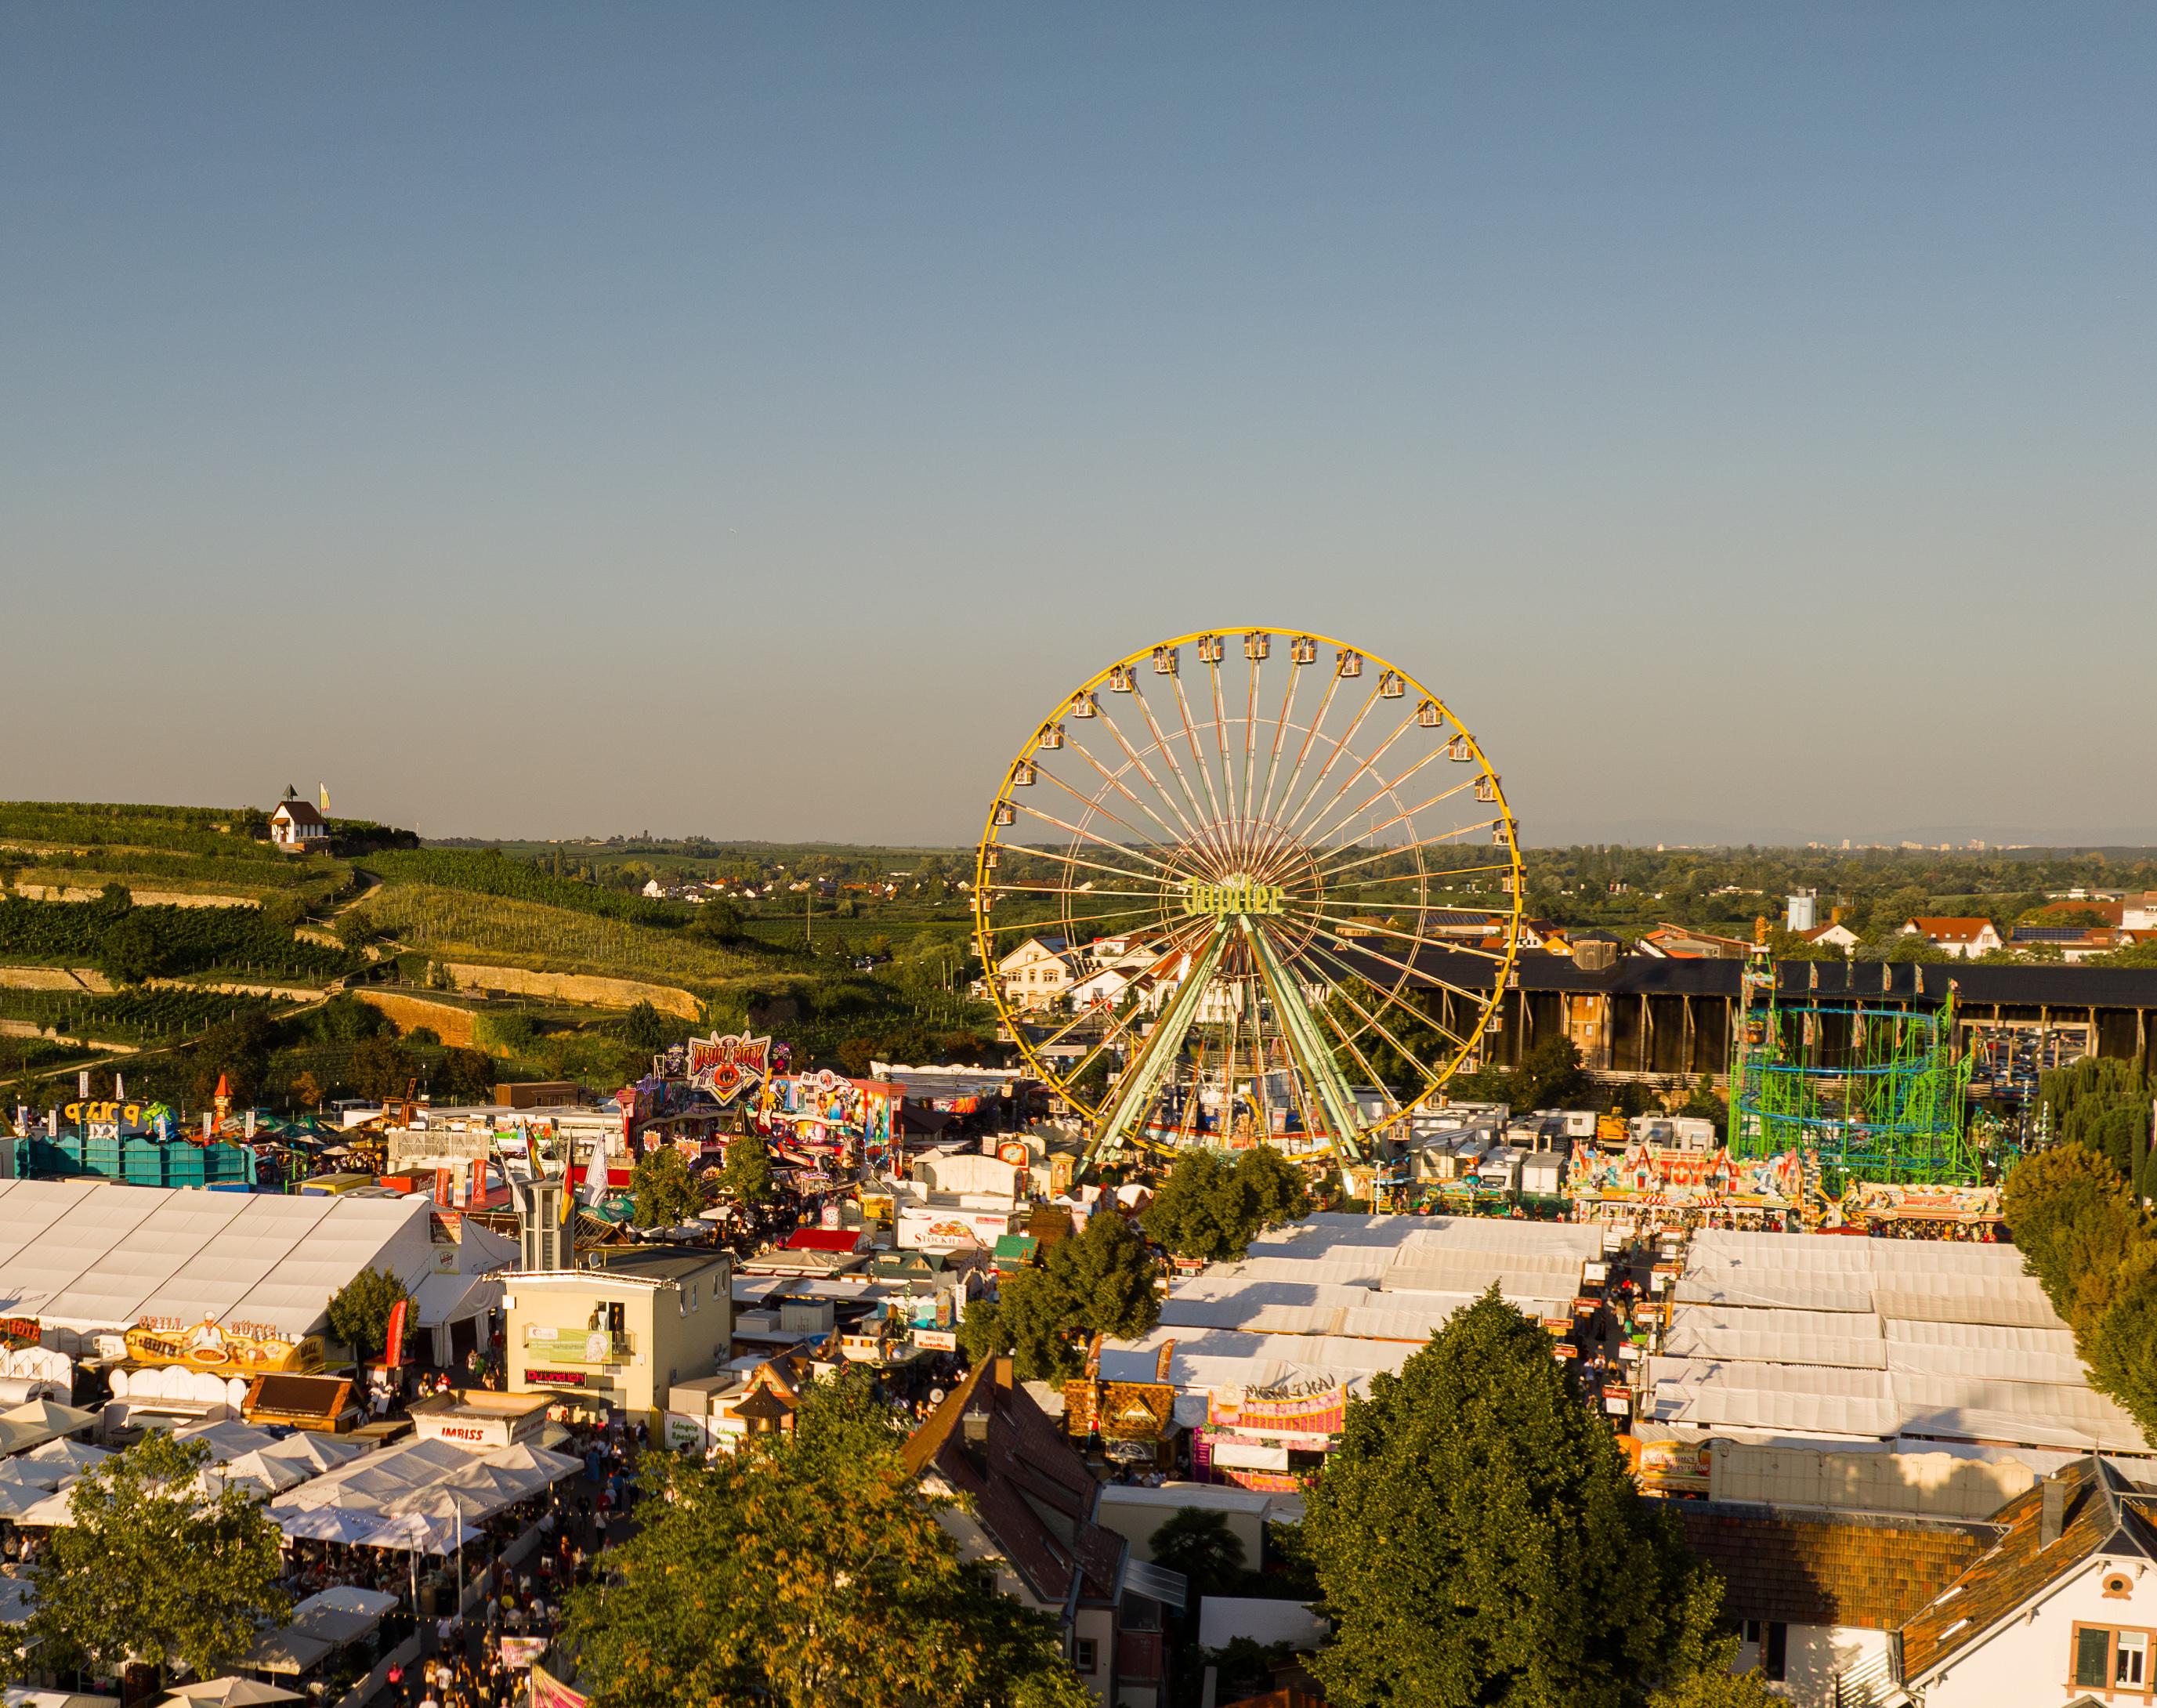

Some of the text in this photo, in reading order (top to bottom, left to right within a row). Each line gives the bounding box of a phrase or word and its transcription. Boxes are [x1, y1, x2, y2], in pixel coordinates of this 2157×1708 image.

[1181, 873, 1285, 922] Jupiter
[693, 1042, 766, 1074] DEVIL ROCK
[139, 1315, 183, 1330] GRILL
[918, 1341, 951, 1350] Kartoffeln
[441, 1428, 483, 1441] IMBISS
